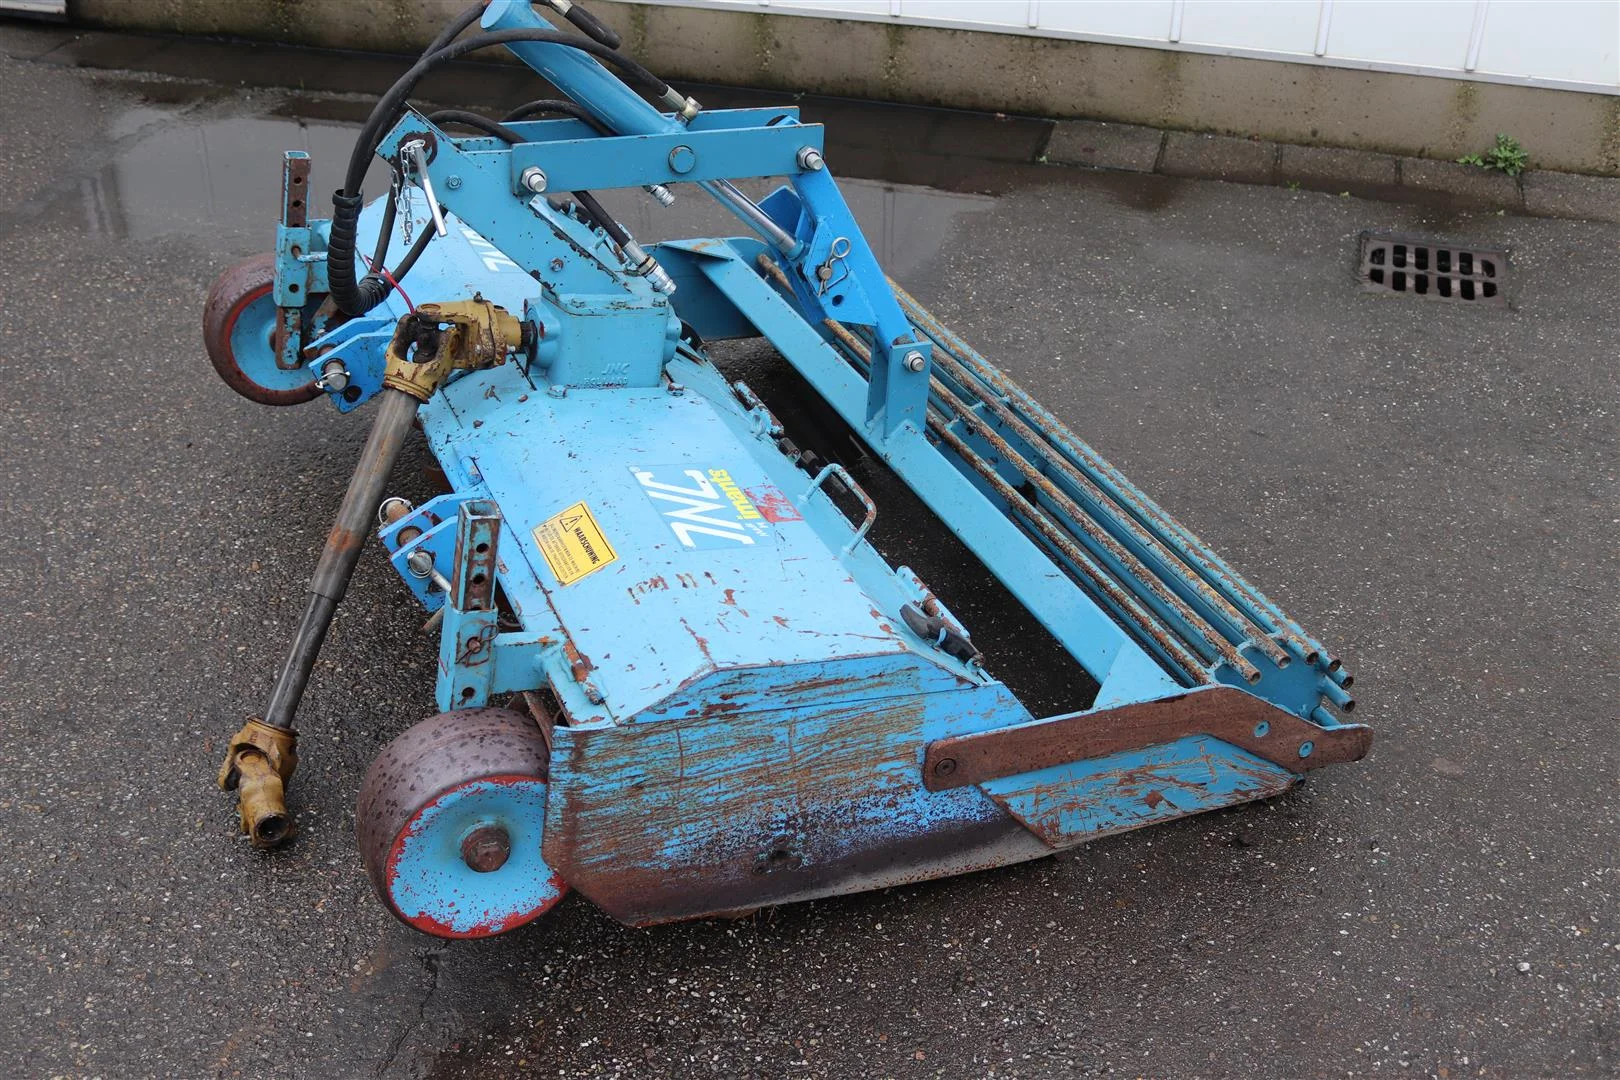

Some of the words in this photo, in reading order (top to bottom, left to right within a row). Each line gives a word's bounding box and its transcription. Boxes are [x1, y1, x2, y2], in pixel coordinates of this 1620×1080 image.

[635, 470, 755, 547] JNC
[708, 469, 761, 520] imants
[574, 527, 600, 564] WAARSCHUWING
